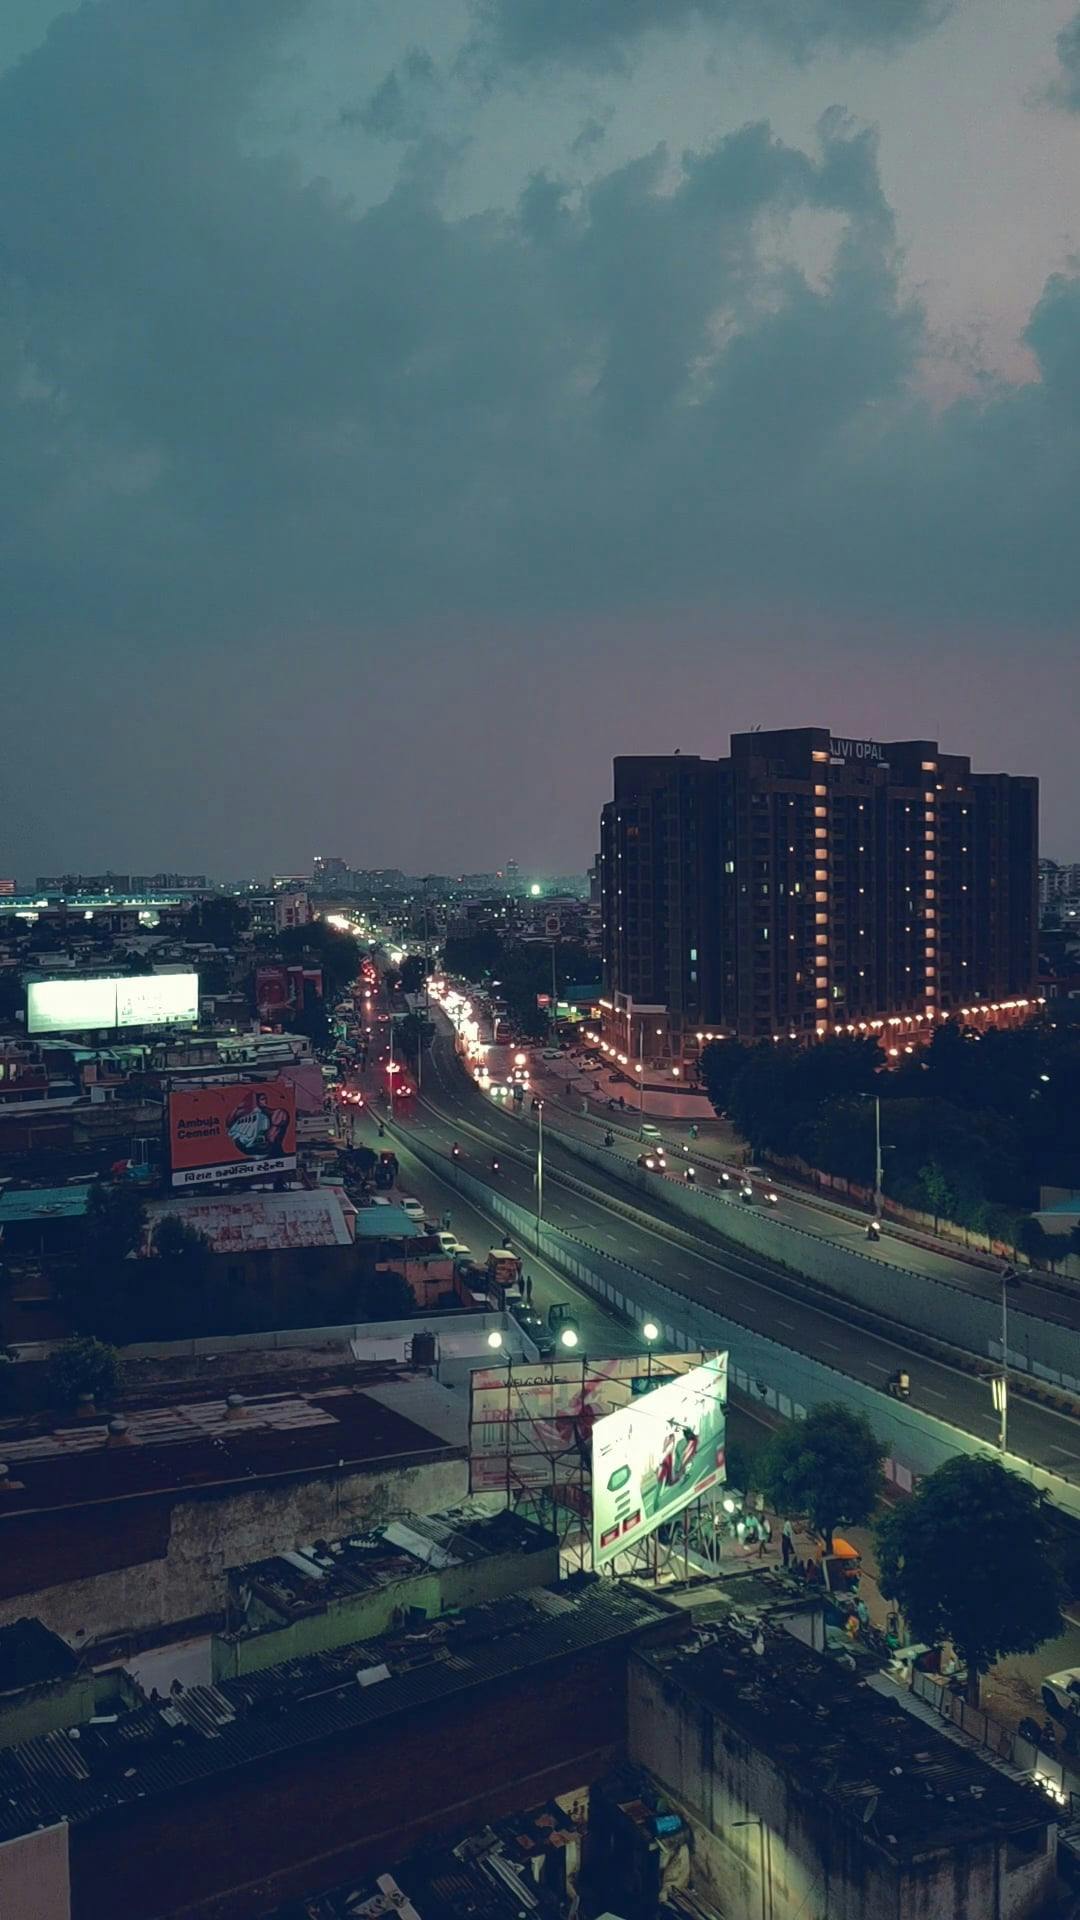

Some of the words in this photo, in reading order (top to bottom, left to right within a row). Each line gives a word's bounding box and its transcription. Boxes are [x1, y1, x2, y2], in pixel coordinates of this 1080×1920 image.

[856, 743, 884, 760] OPAL
[177, 1116, 220, 1129] Ambuja
[177, 1127, 220, 1139] Cement
[503, 1375, 561, 1387] WELCOME
